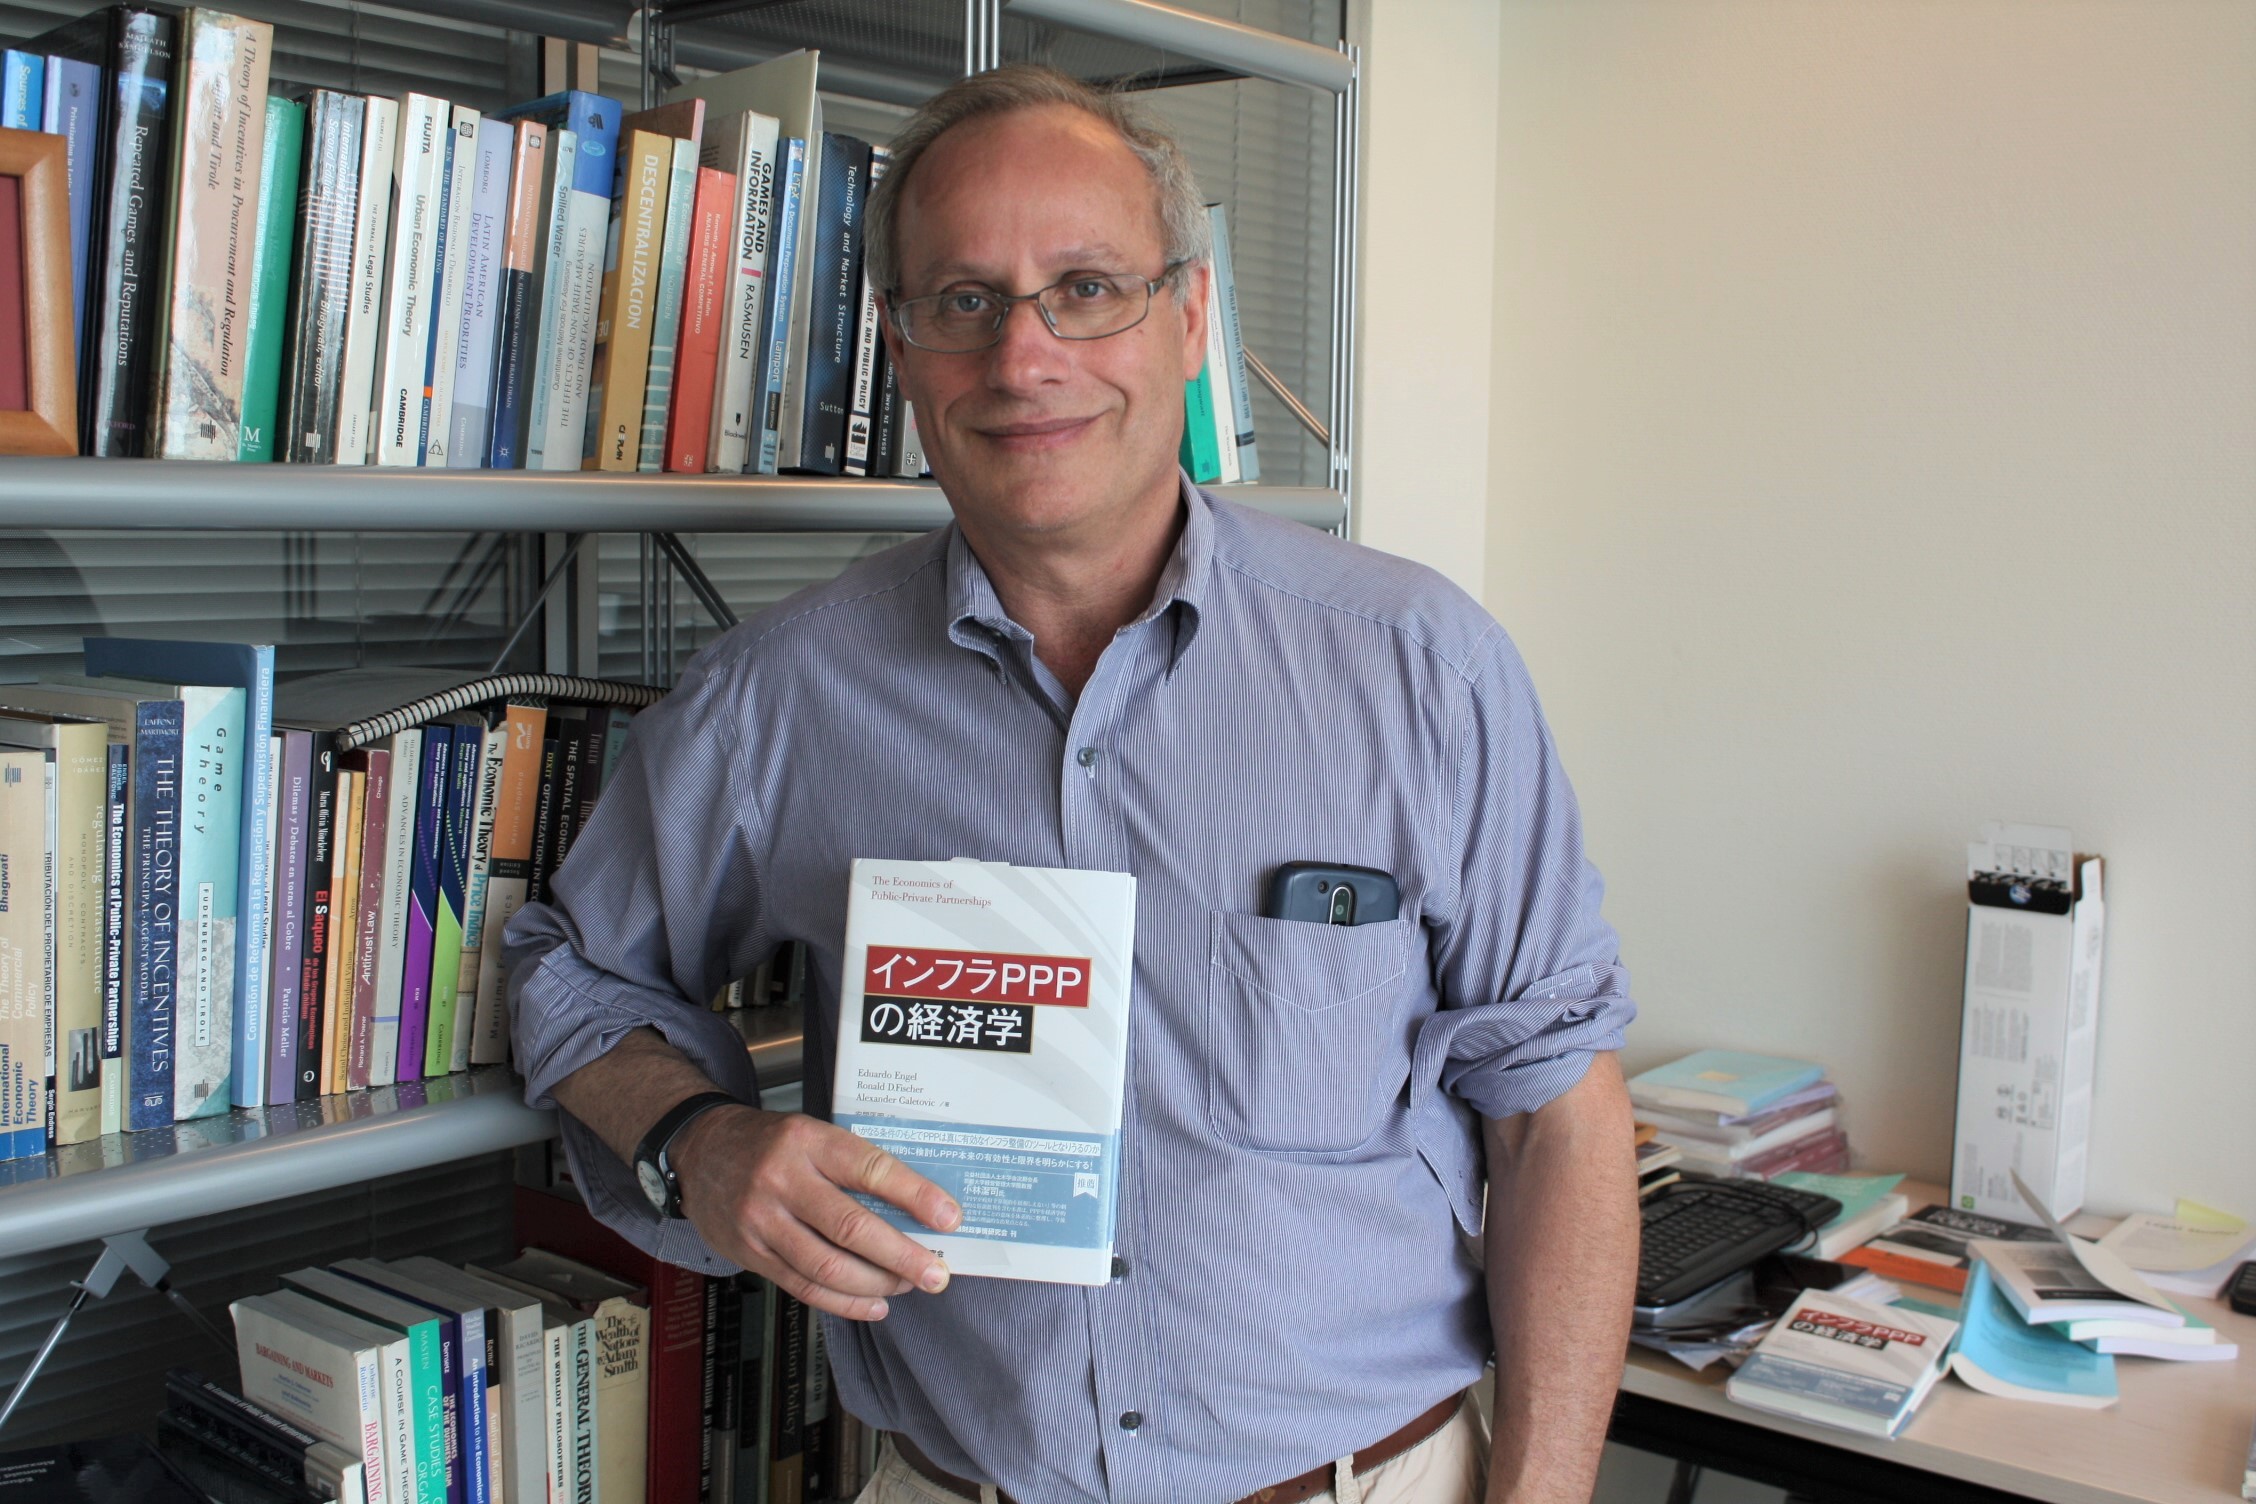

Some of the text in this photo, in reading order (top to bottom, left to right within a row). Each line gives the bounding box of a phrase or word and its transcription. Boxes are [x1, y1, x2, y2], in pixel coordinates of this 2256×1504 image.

[246, 31, 256, 42] A
[238, 47, 256, 91] Theory
[17, 65, 31, 127] Sources of
[234, 111, 251, 177] Incentives
[422, 115, 432, 154] FUJITA
[482, 150, 492, 194] LOMBORG
[553, 186, 568, 258] Spilled Water
[742, 150, 762, 260] INFORMATION
[754, 162, 772, 253] GAMES AND
[117, 126, 148, 366] Repeated Games and Reputations
[228, 195, 244, 273] Procurement
[628, 154, 658, 328] DESCENTRALIZACION
[402, 194, 426, 336] Urban Economic Theory
[476, 215, 494, 317] LATIN AMERICAN
[834, 166, 856, 364] Technology and Market Structure
[225, 278, 236, 305] and
[460, 212, 482, 370] DEVELOPMENT PRIORITIES
[220, 308, 236, 377] Regulation
[576, 263, 594, 398] AND TRADE FACILITATION
[740, 284, 754, 359] RASMUSEN
[773, 340, 783, 382] Lamport
[396, 388, 407, 448] CAMBRIDGE
[820, 402, 844, 415] Sutton
[257, 666, 269, 730] Financiera
[214, 728, 226, 792] Game
[255, 733, 269, 804] Supervisión
[487, 743, 498, 755] The
[544, 752, 554, 780] DIXIT
[568, 740, 578, 762] THE
[194, 744, 210, 834] Theory
[292, 777, 302, 815] Dilemas
[480, 758, 503, 818] Economic
[562, 766, 575, 810] SPATIAL
[258, 808, 266, 816] y
[534, 784, 551, 866] OPTIMIZATION
[252, 819, 266, 884] Regulación
[289, 827, 299, 864] Debates
[472, 820, 494, 863] Theory
[0, 853, 10, 912] Bhagwati
[252, 888, 262, 900] la
[288, 867, 294, 878] en
[470, 874, 487, 906] Price
[534, 869, 541, 878] IN
[872, 876, 954, 888] The Economics of
[92, 805, 104, 993] regulating infrastructure
[140, 827, 151, 1002] THE PRINCIPAL-AGENT MODEL
[152, 754, 174, 1072] THE THEORY OF INCENTIVES
[251, 902, 261, 910] a
[286, 910, 295, 918] al
[312, 890, 328, 954] El Saqueo
[871, 890, 992, 908] Public-Private Partnerships
[108, 804, 124, 1052] The Economics of Public-Private Partnerships
[250, 913, 261, 963] Reforma
[286, 922, 296, 950] Cobre
[362, 910, 376, 985] Antitrust Law
[466, 911, 483, 946] Indice
[12, 948, 22, 1020] Commercial
[249, 966, 259, 981] de
[872, 953, 1082, 998] インフラPPP
[26, 982, 38, 1018] Policy
[45, 994, 52, 1006] DE
[247, 984, 258, 1040] Comisión
[280, 988, 292, 1058] Patricio Meller
[870, 1002, 1022, 1046] の経済学
[0, 1044, 10, 1126] International
[13, 1062, 24, 1125] Economic
[857, 1081, 924, 1094] Ronald D.Fischer
[858, 1068, 917, 1082] Eduardo Engel
[26, 1080, 38, 1124] Theory
[856, 1093, 935, 1107] Alexander Galetovic
[603, 1338, 640, 1351] Nations
[606, 1316, 624, 1328] The
[1802, 1312, 1921, 1344] インフラPPP
[420, 1330, 428, 1370] MASTEN
[472, 1358, 478, 1370] An
[604, 1359, 638, 1378] Smith
[606, 1348, 637, 1364] Adam
[360, 1366, 368, 1411] Rubinstein
[428, 1386, 438, 1419] CASE
[472, 1372, 480, 1425] Introduction
[554, 1360, 562, 1407] WORLDLY
[395, 1358, 409, 1504] A COURSE IN GAME THEOR
[576, 1323, 592, 1504] THE GENERAL THEORY
[784, 1384, 800, 1436] Policy
[430, 1424, 441, 1477] STUDIES
[450, 1411, 458, 1458] ECONOMICS
[556, 1411, 564, 1488] PHILOSOPHERS
[365, 1421, 382, 1502] BARGAINING
[476, 1449, 484, 1494] Economics
